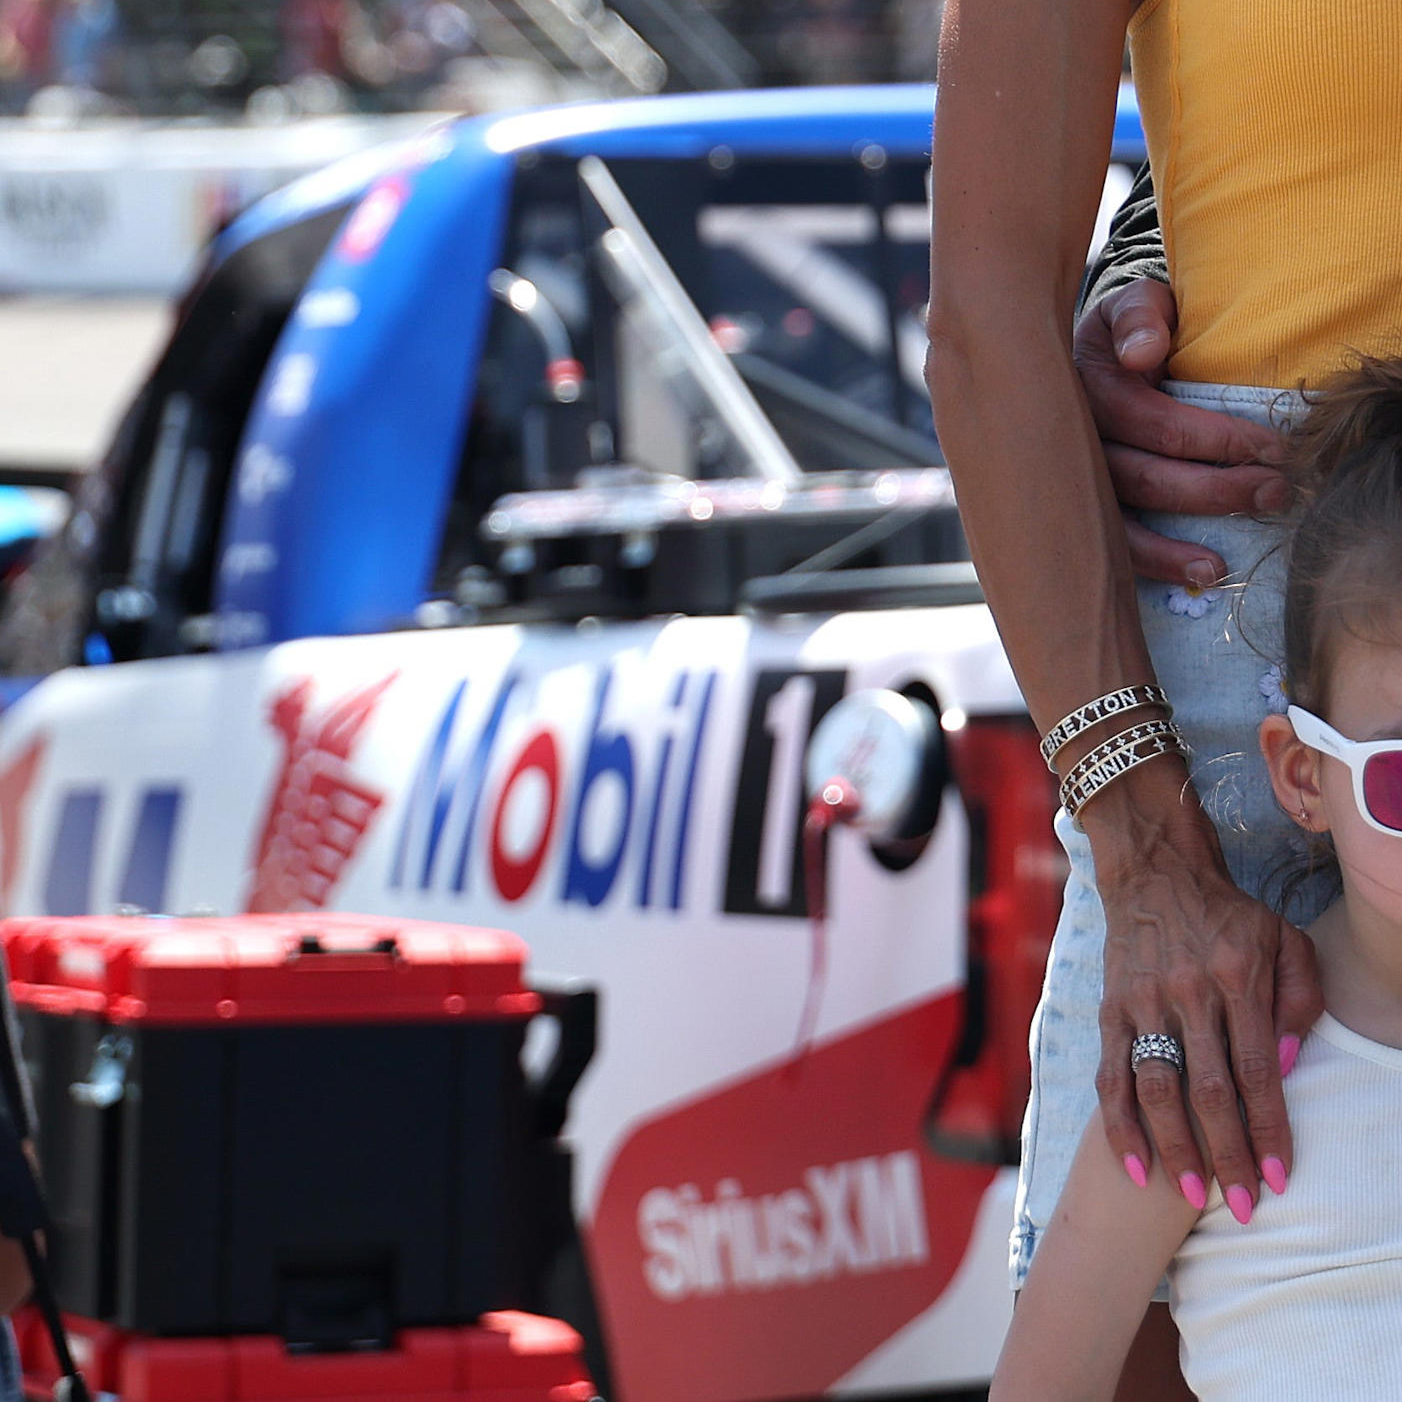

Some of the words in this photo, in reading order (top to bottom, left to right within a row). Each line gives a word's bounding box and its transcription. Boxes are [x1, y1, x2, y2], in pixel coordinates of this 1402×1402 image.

[1044, 688, 1137, 755] BREXTON
[1071, 744, 1141, 807] LENNIX
[388, 668, 718, 911] Mobil
[755, 675, 818, 908] 1
[637, 1148, 931, 1304] SiriusXM
